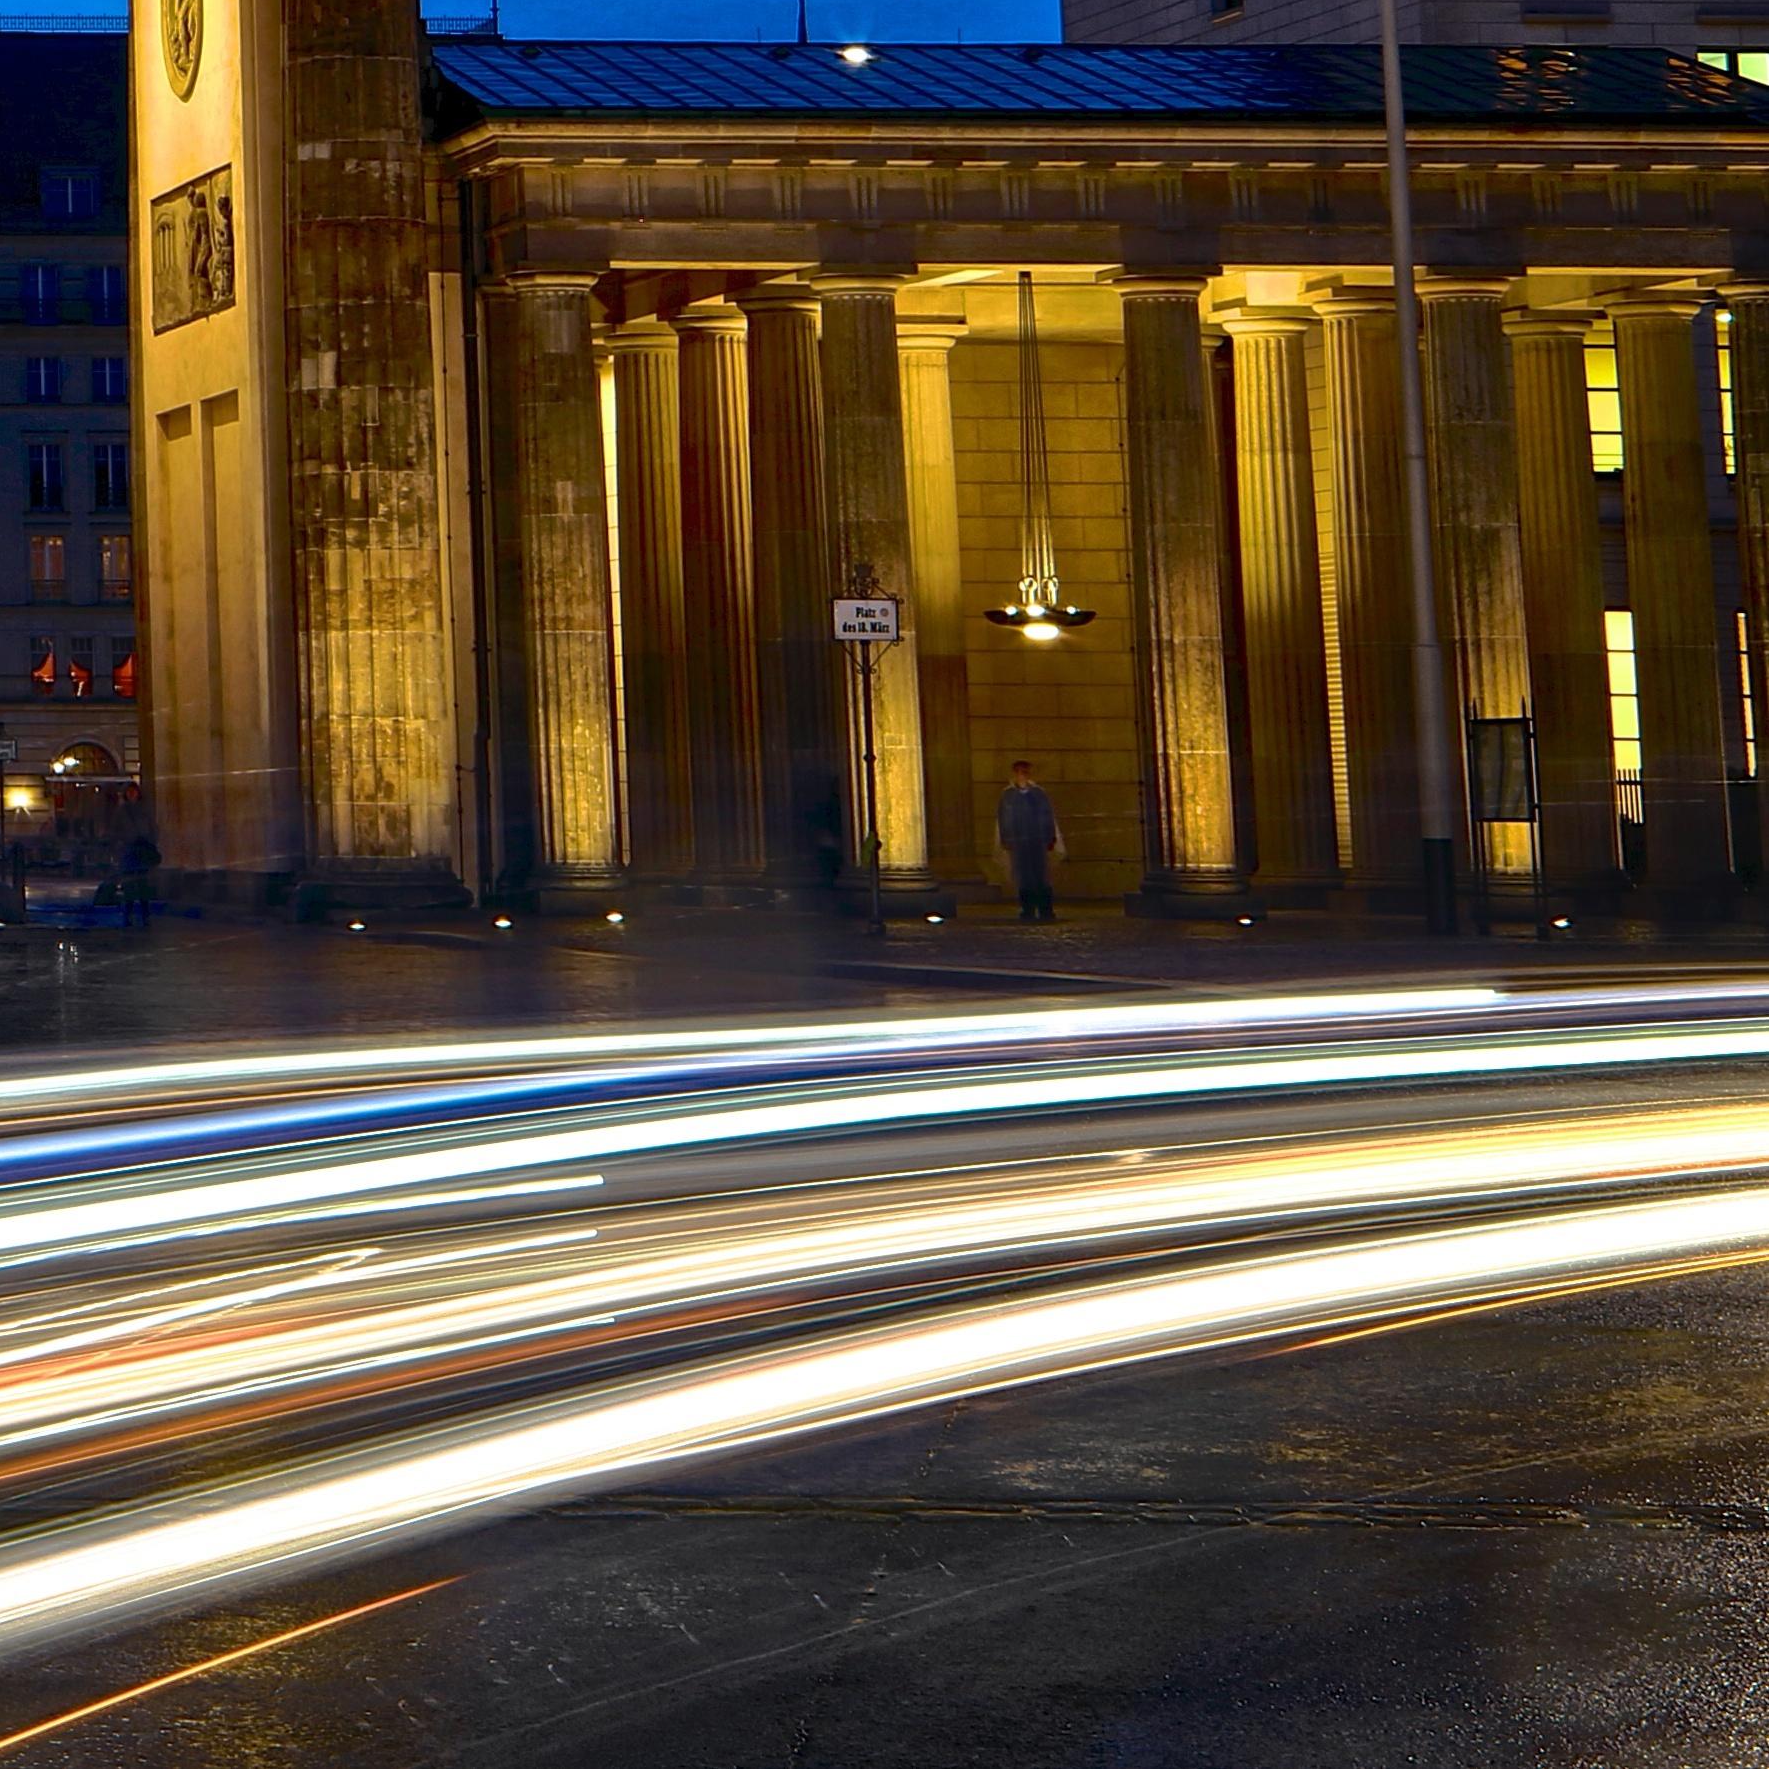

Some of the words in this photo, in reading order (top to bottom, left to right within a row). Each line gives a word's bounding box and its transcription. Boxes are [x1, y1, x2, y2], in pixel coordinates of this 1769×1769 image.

[855, 607, 876, 618] Platz
[842, 622, 856, 633] des
[870, 621, 890, 633] März
